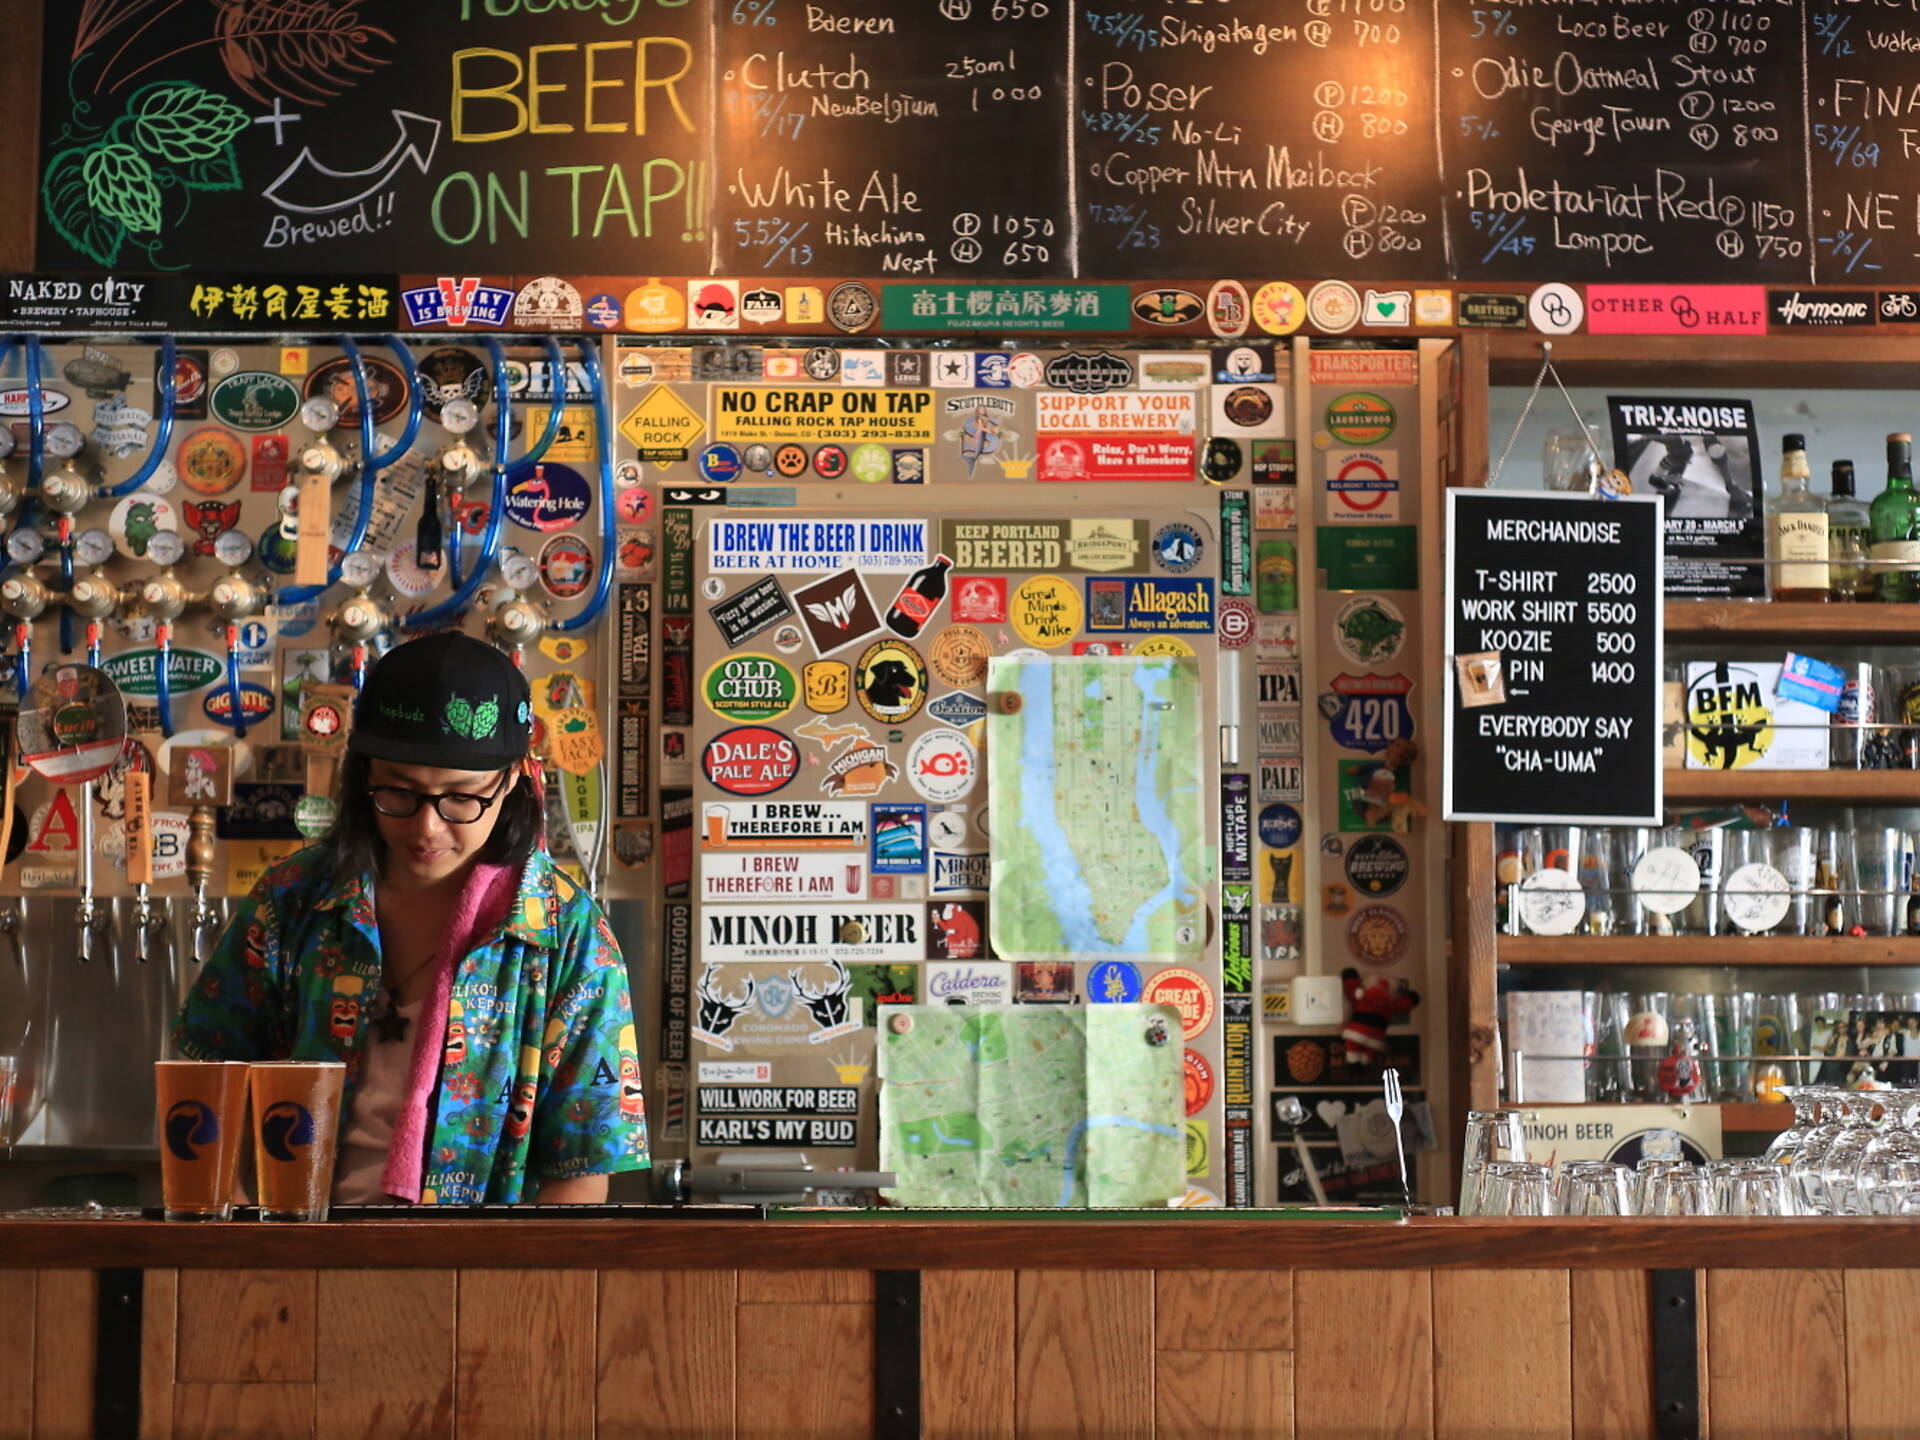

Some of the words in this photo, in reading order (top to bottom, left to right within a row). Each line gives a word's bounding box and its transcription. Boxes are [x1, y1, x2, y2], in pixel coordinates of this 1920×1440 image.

[1354, 20, 1401, 47] 700
[1471, 10, 1519, 39] 5%
[1557, 14, 1607, 38] Loco
[1613, 14, 1670, 40] Beer
[1721, 12, 1771, 32] 1100
[1727, 36, 1768, 55] 700
[742, 51, 870, 92] Clutch
[946, 49, 1016, 79] 250ml
[1472, 56, 1553, 100] Odie
[1553, 50, 1660, 96] Oatmeal
[1671, 54, 1758, 88] Stout
[450, 37, 698, 142] BEER
[1104, 61, 1213, 112] Poser
[1350, 85, 1409, 105] 1200
[972, 86, 1042, 112] 1000
[1722, 98, 1776, 116] 1200
[1172, 120, 1242, 145] No-Li
[1360, 113, 1408, 138] 800
[1734, 124, 1779, 147] 800
[1105, 152, 1189, 195] Copper
[1197, 150, 1257, 189] Mtn
[431, 169, 530, 245] ON
[545, 157, 707, 243] TAP!!
[738, 166, 852, 209] White
[858, 170, 923, 215] Ale
[1467, 168, 1652, 221] Proletariat
[1656, 169, 1718, 222] Red
[264, 191, 398, 248] Brewed!!
[1378, 206, 1427, 225] 1200
[1846, 192, 1900, 231] NE
[825, 220, 926, 248] Hitachino
[993, 215, 1055, 240] 1050
[1378, 229, 1422, 252] 800
[1554, 215, 1655, 268] Lompoc
[1756, 239, 1802, 259] 750
[882, 249, 938, 274] Nest
[1003, 242, 1049, 266] 650
[8, 280, 82, 301] NAKED
[189, 283, 390, 321] 伊勢角屋麦酒
[413, 292, 502, 307] VICTORY
[418, 307, 432, 321] IS
[436, 306, 497, 321] BREWING
[1591, 298, 1664, 313] OTHER
[1706, 311, 1762, 325] HALF
[1778, 291, 1868, 324] Harmonic
[1315, 354, 1413, 371] TRANSPORTER
[721, 391, 757, 413] NO
[765, 391, 835, 413] CRAP
[841, 391, 878, 413] ON
[884, 391, 931, 414] TAP
[1038, 395, 1130, 412] SUPPORT
[1136, 395, 1192, 411] YOUR
[634, 416, 691, 428] FALLING
[735, 416, 793, 427] FALLING
[796, 416, 837, 427] ROCK
[839, 416, 866, 427] TAP
[868, 416, 915, 427] HOUSE
[1039, 413, 1092, 429] LOCAL
[1100, 413, 1181, 429] BREWERY
[1330, 414, 1392, 425] LAURELWOOD
[1620, 404, 1748, 429] TRI-X-NOISE
[643, 432, 682, 444] ROCK
[817, 429, 858, 439] (303)
[861, 429, 931, 439] 293-8338
[1127, 443, 1156, 456] Don't
[505, 496, 557, 513] Watering
[558, 496, 585, 511] Hole
[713, 523, 719, 552] I
[724, 523, 775, 552] BREW
[779, 523, 810, 552] THE
[815, 523, 856, 552] BEER
[860, 523, 866, 552] I
[871, 523, 925, 552] DRINK
[955, 525, 989, 540] KEEP
[993, 525, 1060, 540] PORTLAND
[1486, 519, 1621, 544] MERCHANDISE
[713, 554, 761, 568] BEER
[765, 554, 788, 568] AT
[792, 554, 844, 568] HOME
[955, 540, 1061, 568] BEERED
[1020, 586, 1057, 600] Great
[1475, 570, 1558, 593] T-SHIRT
[1587, 573, 1636, 595] 2500
[1027, 599, 1067, 612] Minds
[1128, 581, 1211, 620] Allagash
[1461, 599, 1516, 621] WORK
[1522, 601, 1578, 623] SHIRT
[1587, 602, 1636, 624] 5500
[1023, 611, 1060, 626] Drink
[1036, 623, 1073, 638] Alike
[1128, 617, 1156, 631] Always
[1157, 619, 1168, 629] an
[1481, 629, 1552, 652] KOOZIE
[1597, 632, 1636, 654] 500
[724, 661, 776, 680] OLD
[1510, 660, 1544, 682] PIN
[1591, 662, 1635, 684] 1400
[717, 679, 783, 698] CHUB
[1258, 674, 1301, 702] IPA
[1695, 682, 1763, 714] BFM
[714, 700, 750, 709] SCOTTISH
[750, 700, 772, 709] STYLE
[772, 700, 788, 709] ALE
[1344, 698, 1400, 740] 420
[1479, 714, 1590, 739] EVERYBODY
[1595, 717, 1633, 739] SAY
[710, 740, 794, 763] DALE'S
[834, 748, 886, 776] MICHIGAN
[711, 764, 753, 783] PALE
[760, 764, 793, 780] ALE
[1261, 767, 1300, 791] PALE
[752, 805, 758, 818] I
[730, 821, 822, 834] THEREFORE
[828, 821, 833, 833] I
[840, 821, 864, 834] AM
[1235, 795, 1248, 862] MIXTAPE
[742, 857, 747, 872] I
[753, 856, 800, 872] BREW
[707, 876, 793, 893] THEREFORE
[799, 877, 803, 892] I
[808, 876, 834, 892] AM
[949, 873, 984, 887] BEER
[709, 914, 818, 946] MINOH
[668, 906, 688, 999] GODFATHER
[1154, 987, 1201, 1003] GREAT
[669, 1000, 686, 1019] OF
[667, 1020, 684, 1060] BEER
[700, 1088, 735, 1108] WILL
[738, 1088, 784, 1108] WORK
[786, 1088, 816, 1108] FOR
[818, 1088, 857, 1108] BEER
[700, 1120, 771, 1140] KARL'S
[775, 1120, 806, 1140] MY
[811, 1120, 854, 1140] BUD
